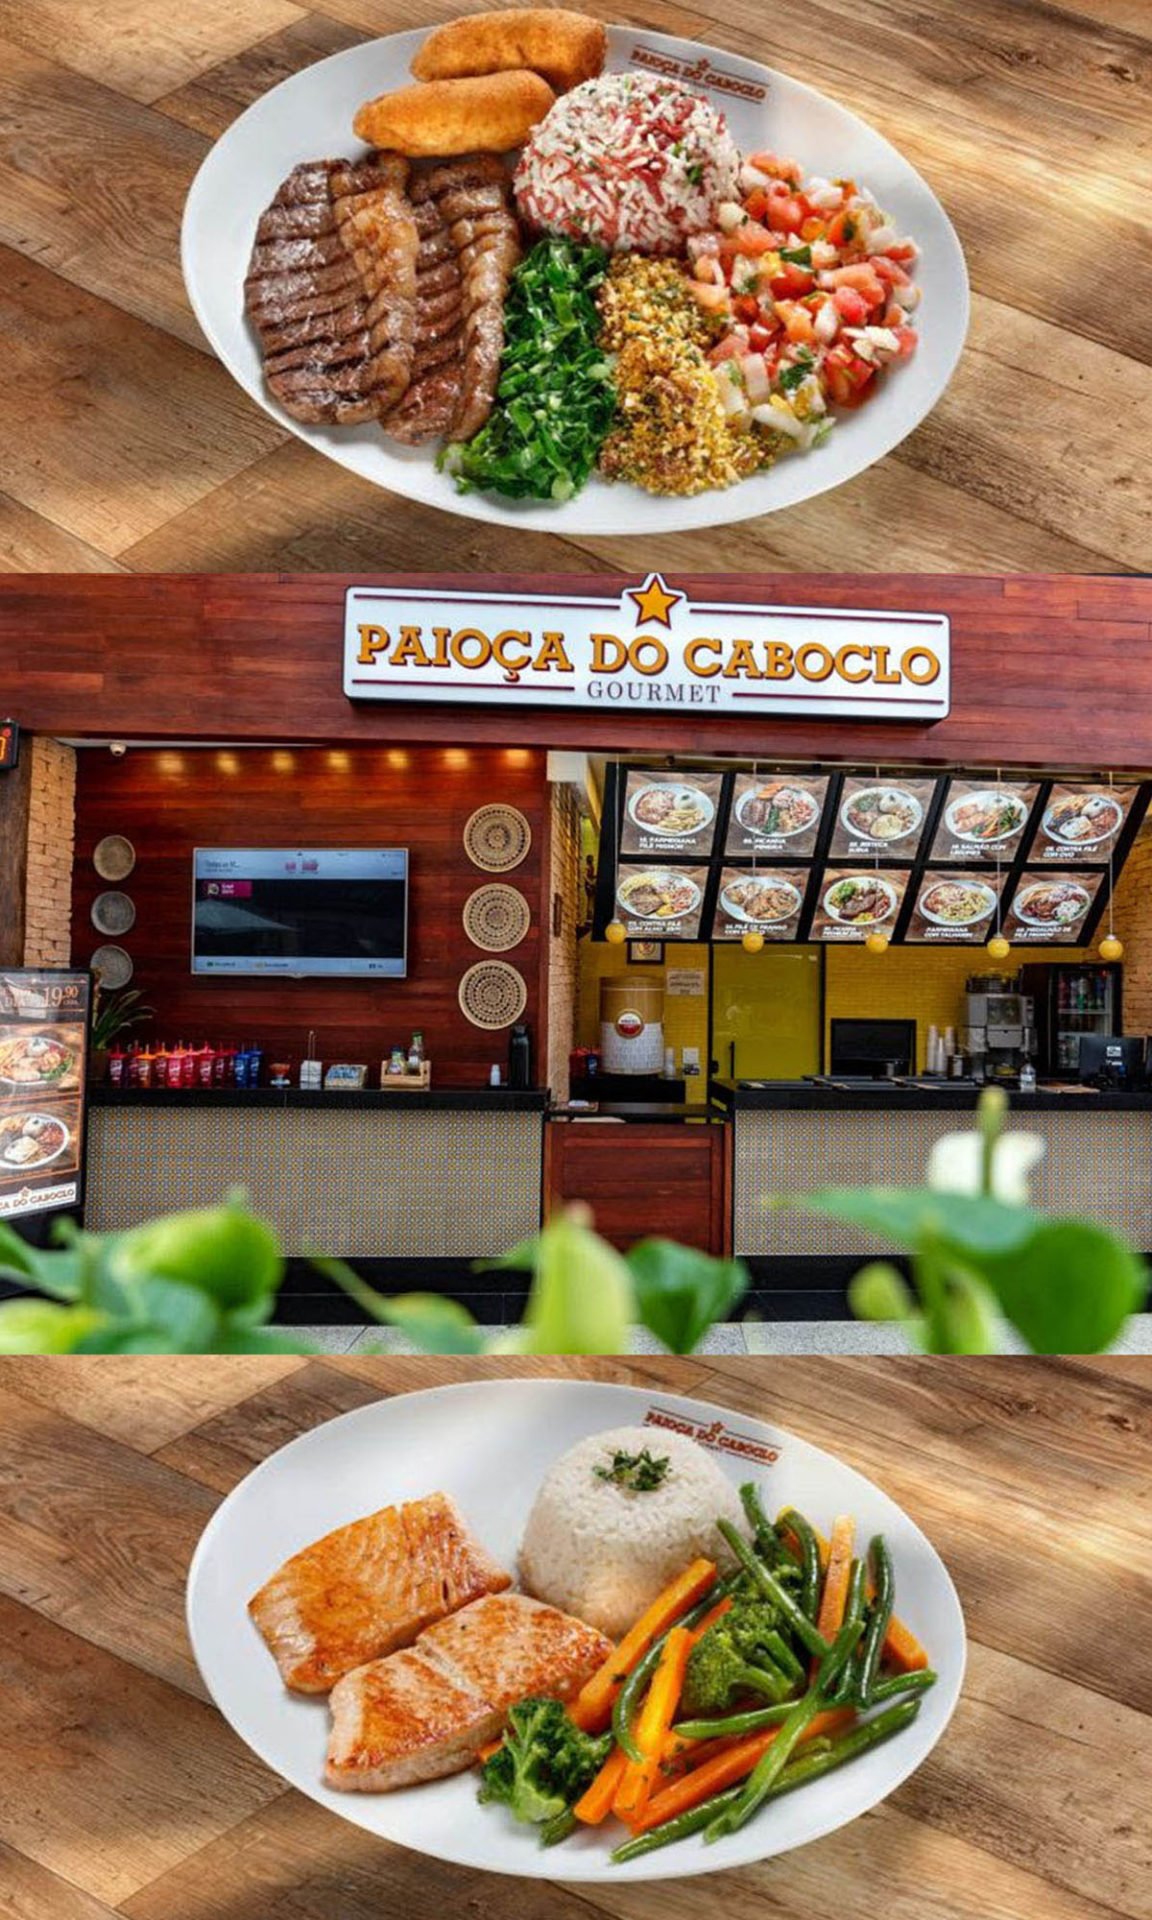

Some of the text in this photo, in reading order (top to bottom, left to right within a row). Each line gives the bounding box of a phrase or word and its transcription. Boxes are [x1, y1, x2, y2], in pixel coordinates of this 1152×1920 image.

[682, 66, 702, 80] DO
[704, 73, 766, 99] CABOCLO
[357, 624, 941, 685] PAIOÇA DO CABOCLO
[586, 680, 722, 704] GOURMET
[13, 1198, 28, 1207] DO
[30, 1189, 74, 1203] CABOCLO
[696, 1428, 716, 1442] DO
